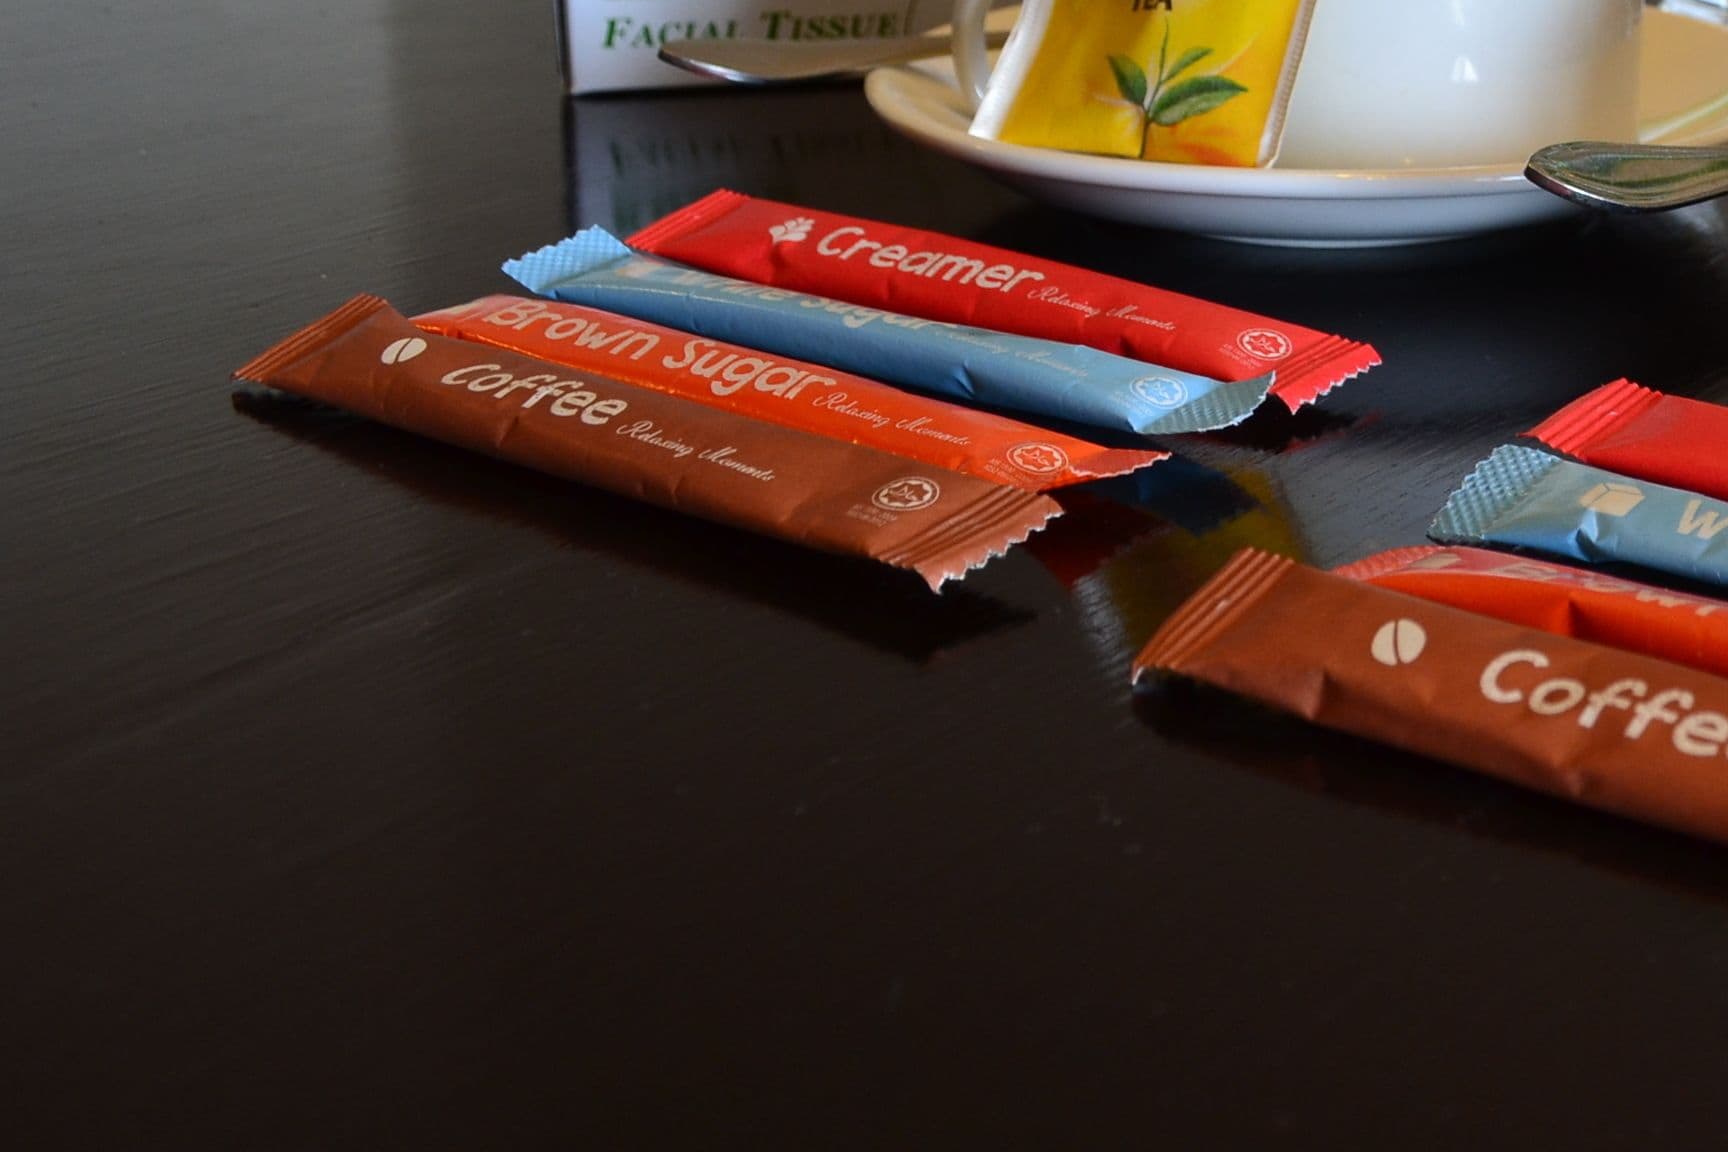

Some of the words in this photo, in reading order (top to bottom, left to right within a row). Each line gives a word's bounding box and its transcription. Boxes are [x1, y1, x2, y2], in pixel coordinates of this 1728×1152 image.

[604, 15, 740, 48] FACIAL
[760, 10, 898, 41] TISSUE
[816, 226, 1046, 295] Creamer
[1027, 285, 1100, 321] Relaxing
[440, 362, 629, 426] Coffee
[615, 418, 695, 460] Relaxing
[482, 298, 661, 362] Brown
[662, 330, 838, 399] Sugar
[811, 389, 889, 430] Relaxing
